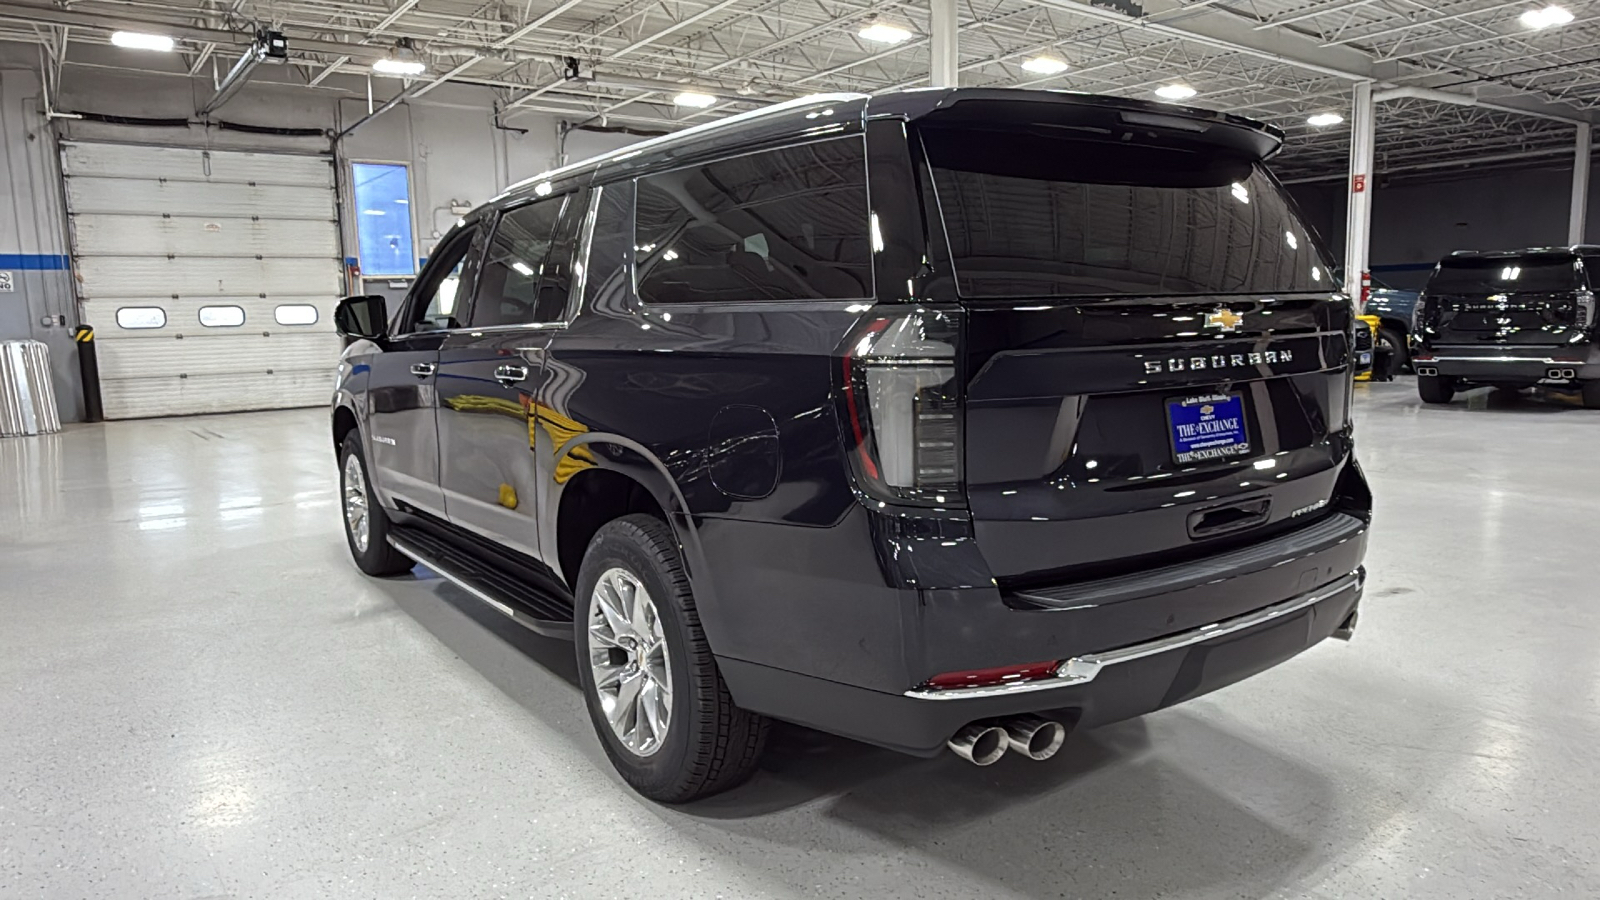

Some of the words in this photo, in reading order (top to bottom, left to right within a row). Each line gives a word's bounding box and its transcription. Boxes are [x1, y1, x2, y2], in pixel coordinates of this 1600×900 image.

[1144, 350, 1293, 374] SUBURBAN
[1177, 423, 1197, 437] THE
[1199, 418, 1239, 434] EXCHANGE
[1177, 452, 1192, 462] THE
[1197, 446, 1237, 460] EXCHANGE
